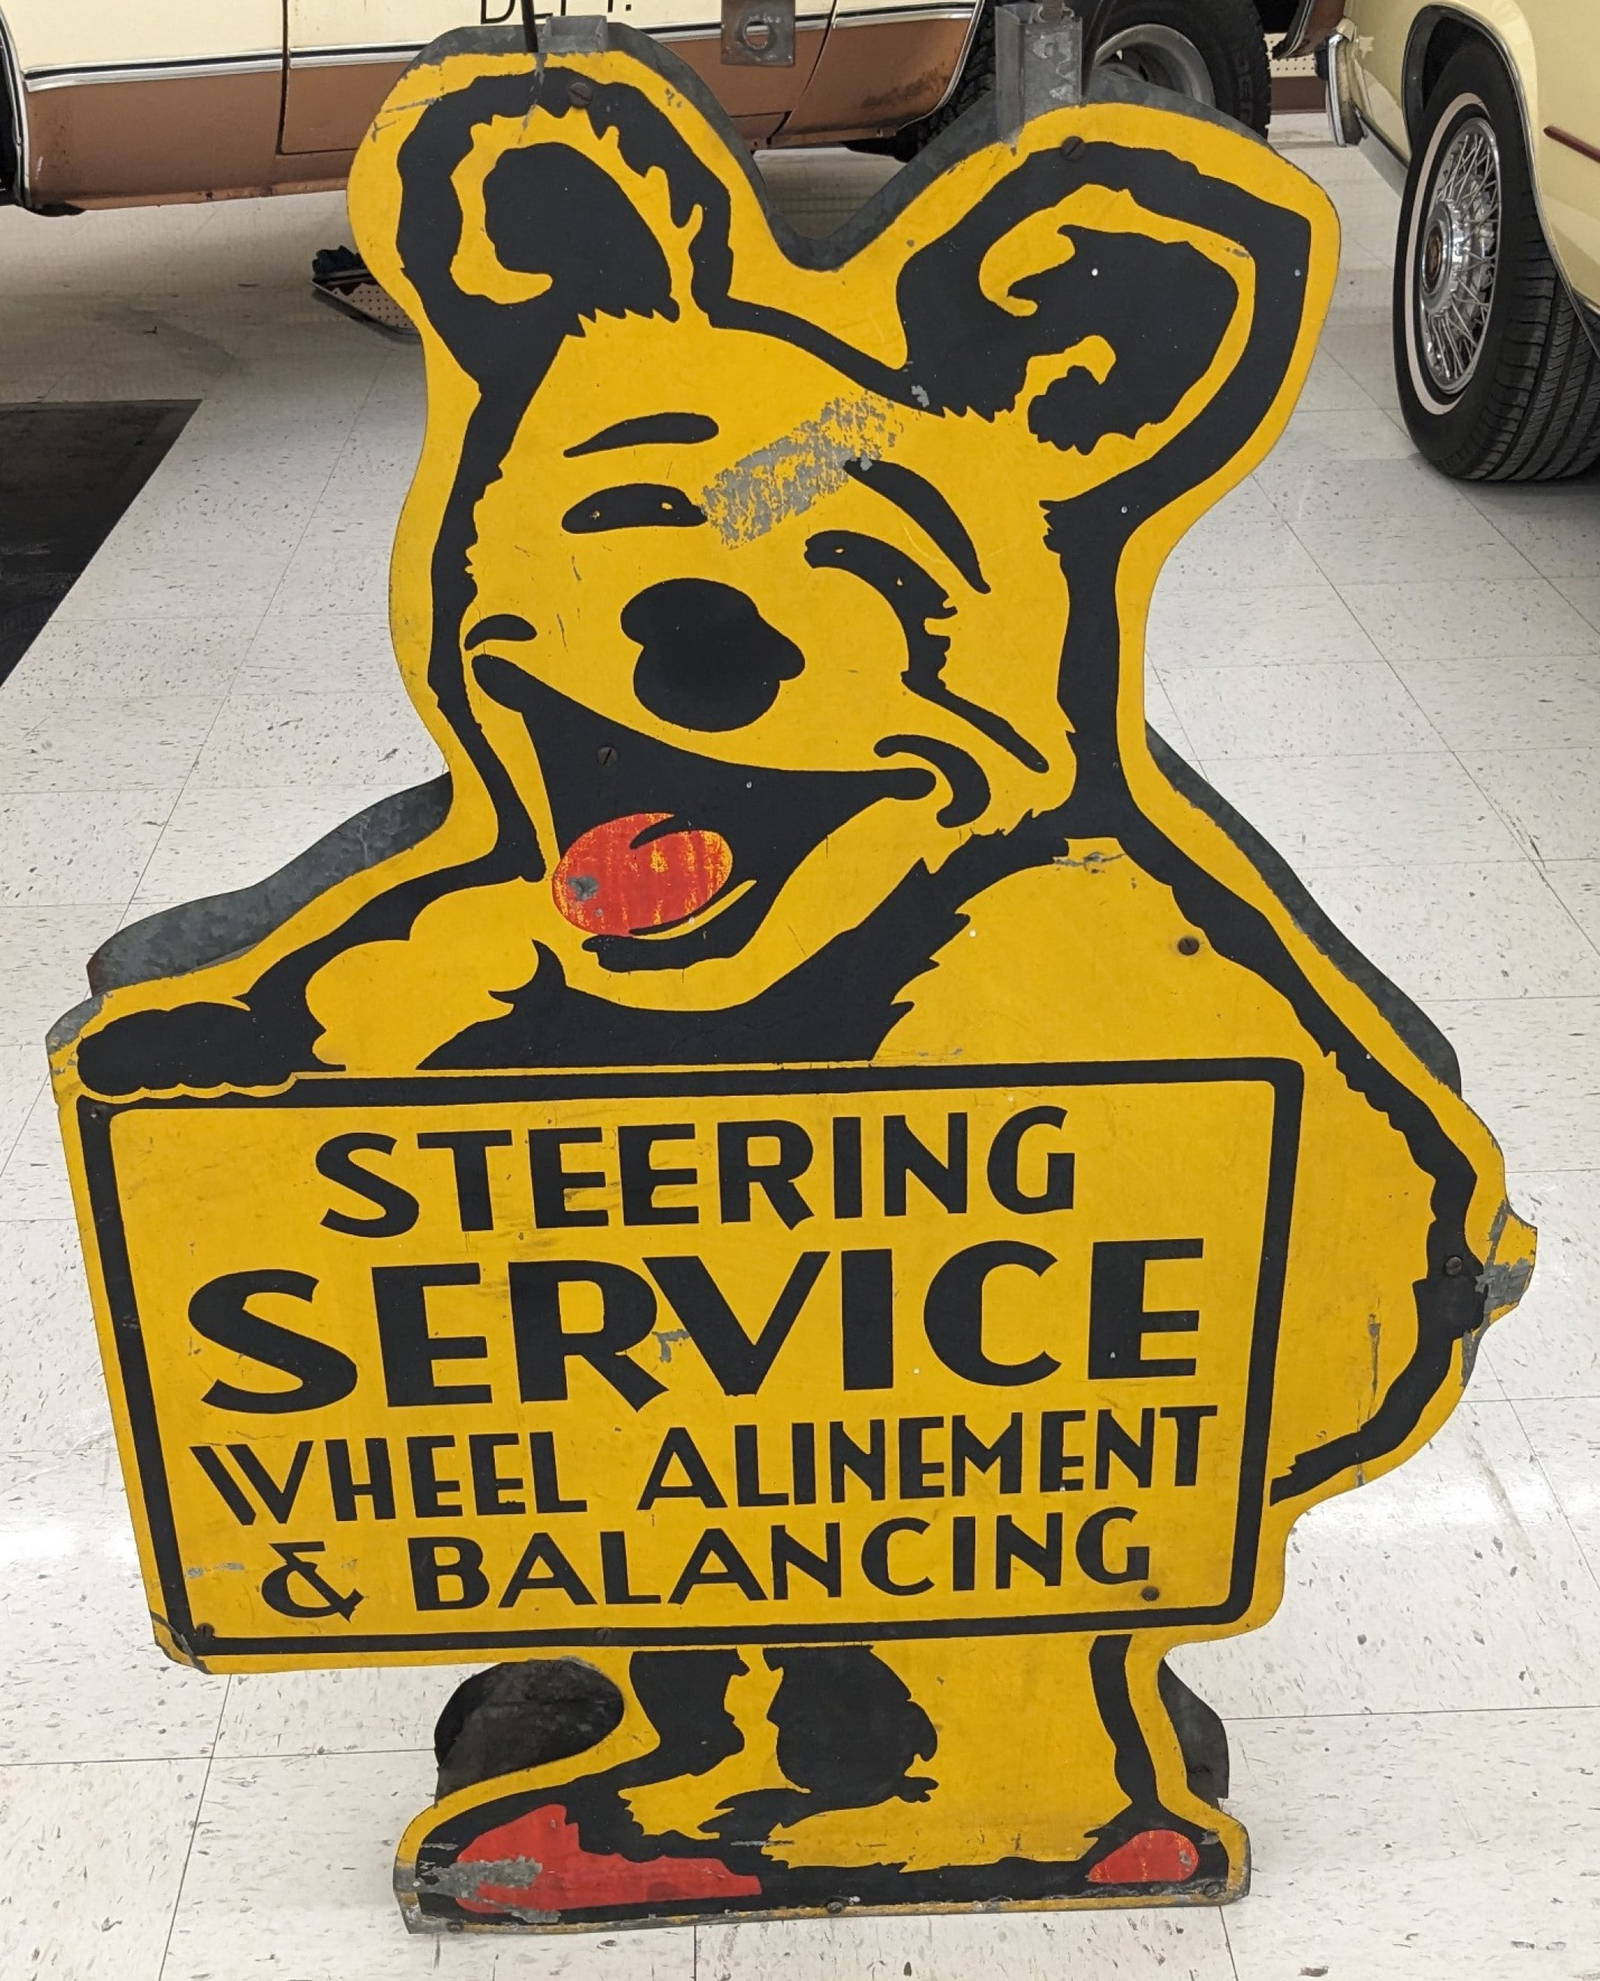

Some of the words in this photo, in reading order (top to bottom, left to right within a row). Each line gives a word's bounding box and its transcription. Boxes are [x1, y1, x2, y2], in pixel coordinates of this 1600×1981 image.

[316, 1106, 1075, 1238] STEERING
[188, 1238, 1203, 1414] SERVICE
[190, 1431, 588, 1526] WHEEL
[636, 1405, 1217, 1511] ALINEMENT
[262, 1541, 364, 1622] &
[407, 1507, 1150, 1612] BALANCING
